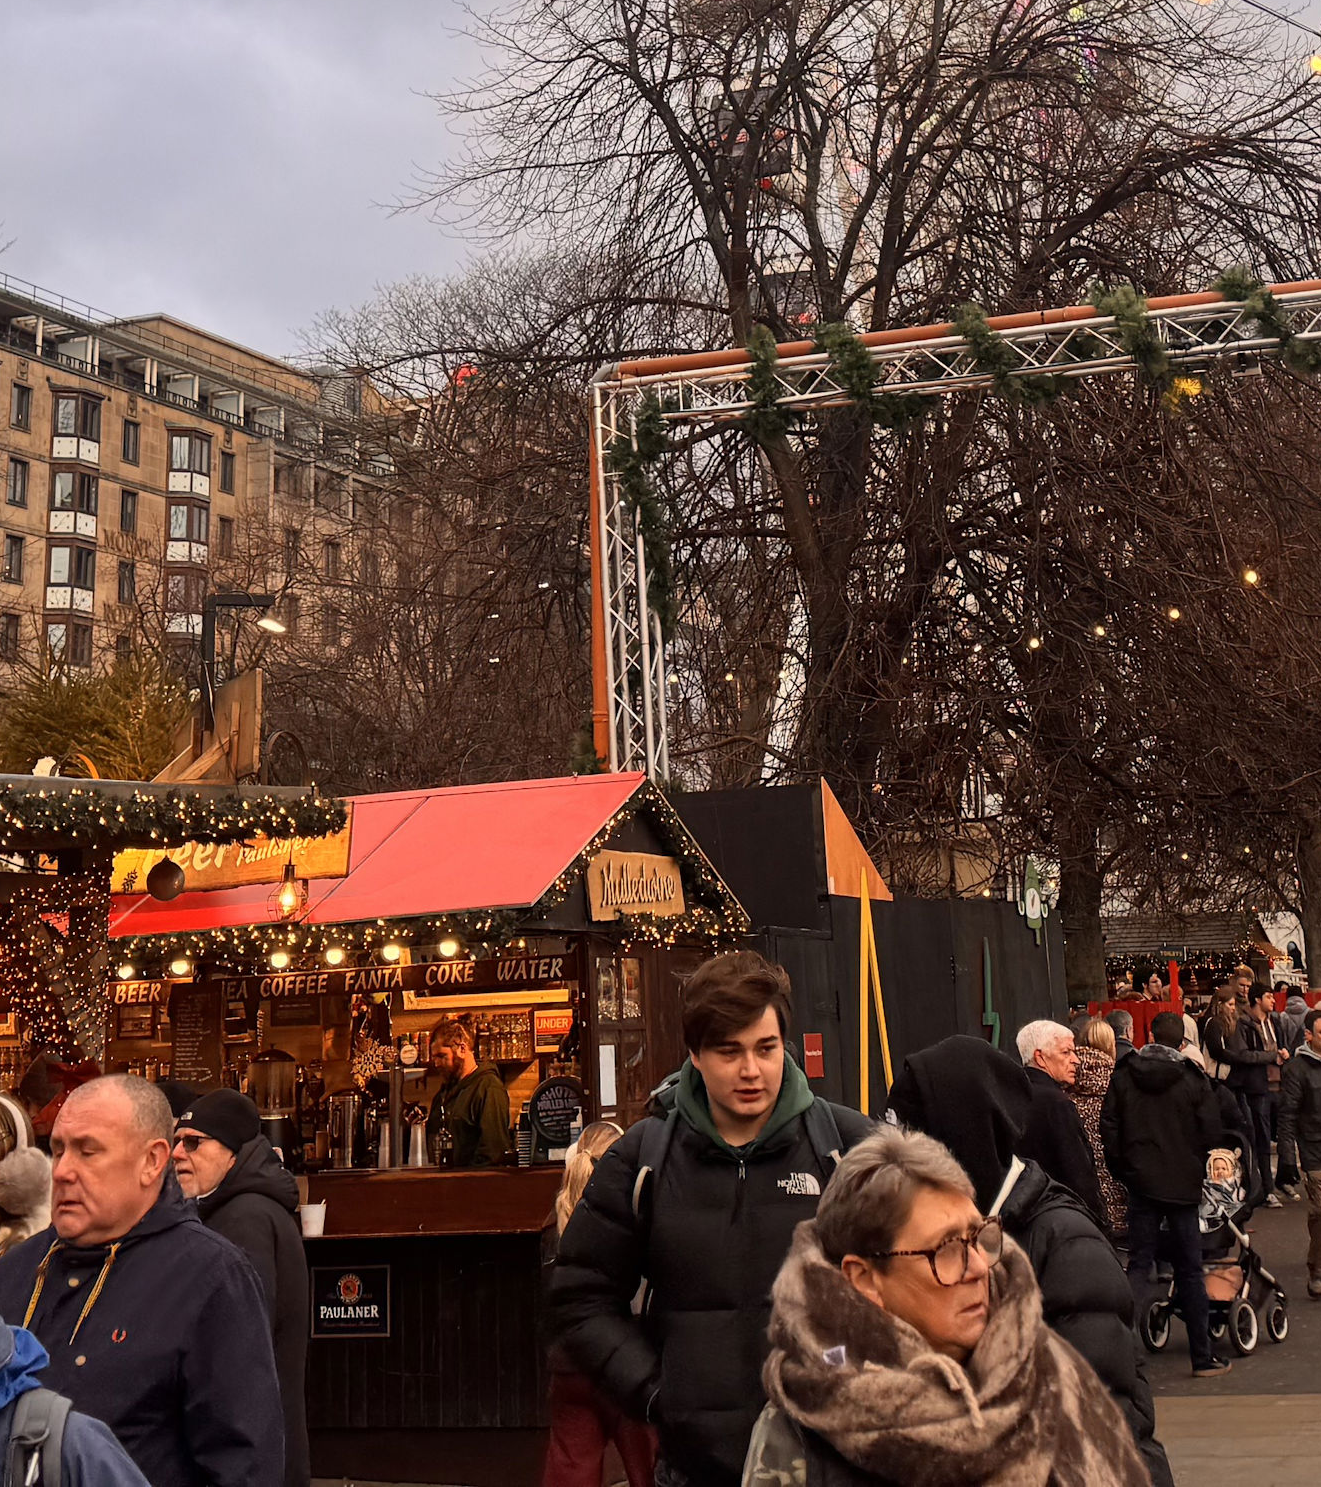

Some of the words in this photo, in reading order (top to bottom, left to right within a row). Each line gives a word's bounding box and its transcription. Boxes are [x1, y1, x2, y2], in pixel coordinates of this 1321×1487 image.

[141, 839, 232, 874] eer
[259, 974, 328, 998] COFFEE
[344, 966, 404, 990] FANTA
[425, 960, 476, 986] COKE
[495, 957, 564, 982] WATER
[114, 982, 162, 1005] BEER
[536, 1018, 568, 1029] UNDER
[320, 1305, 380, 1319] PAULANER
